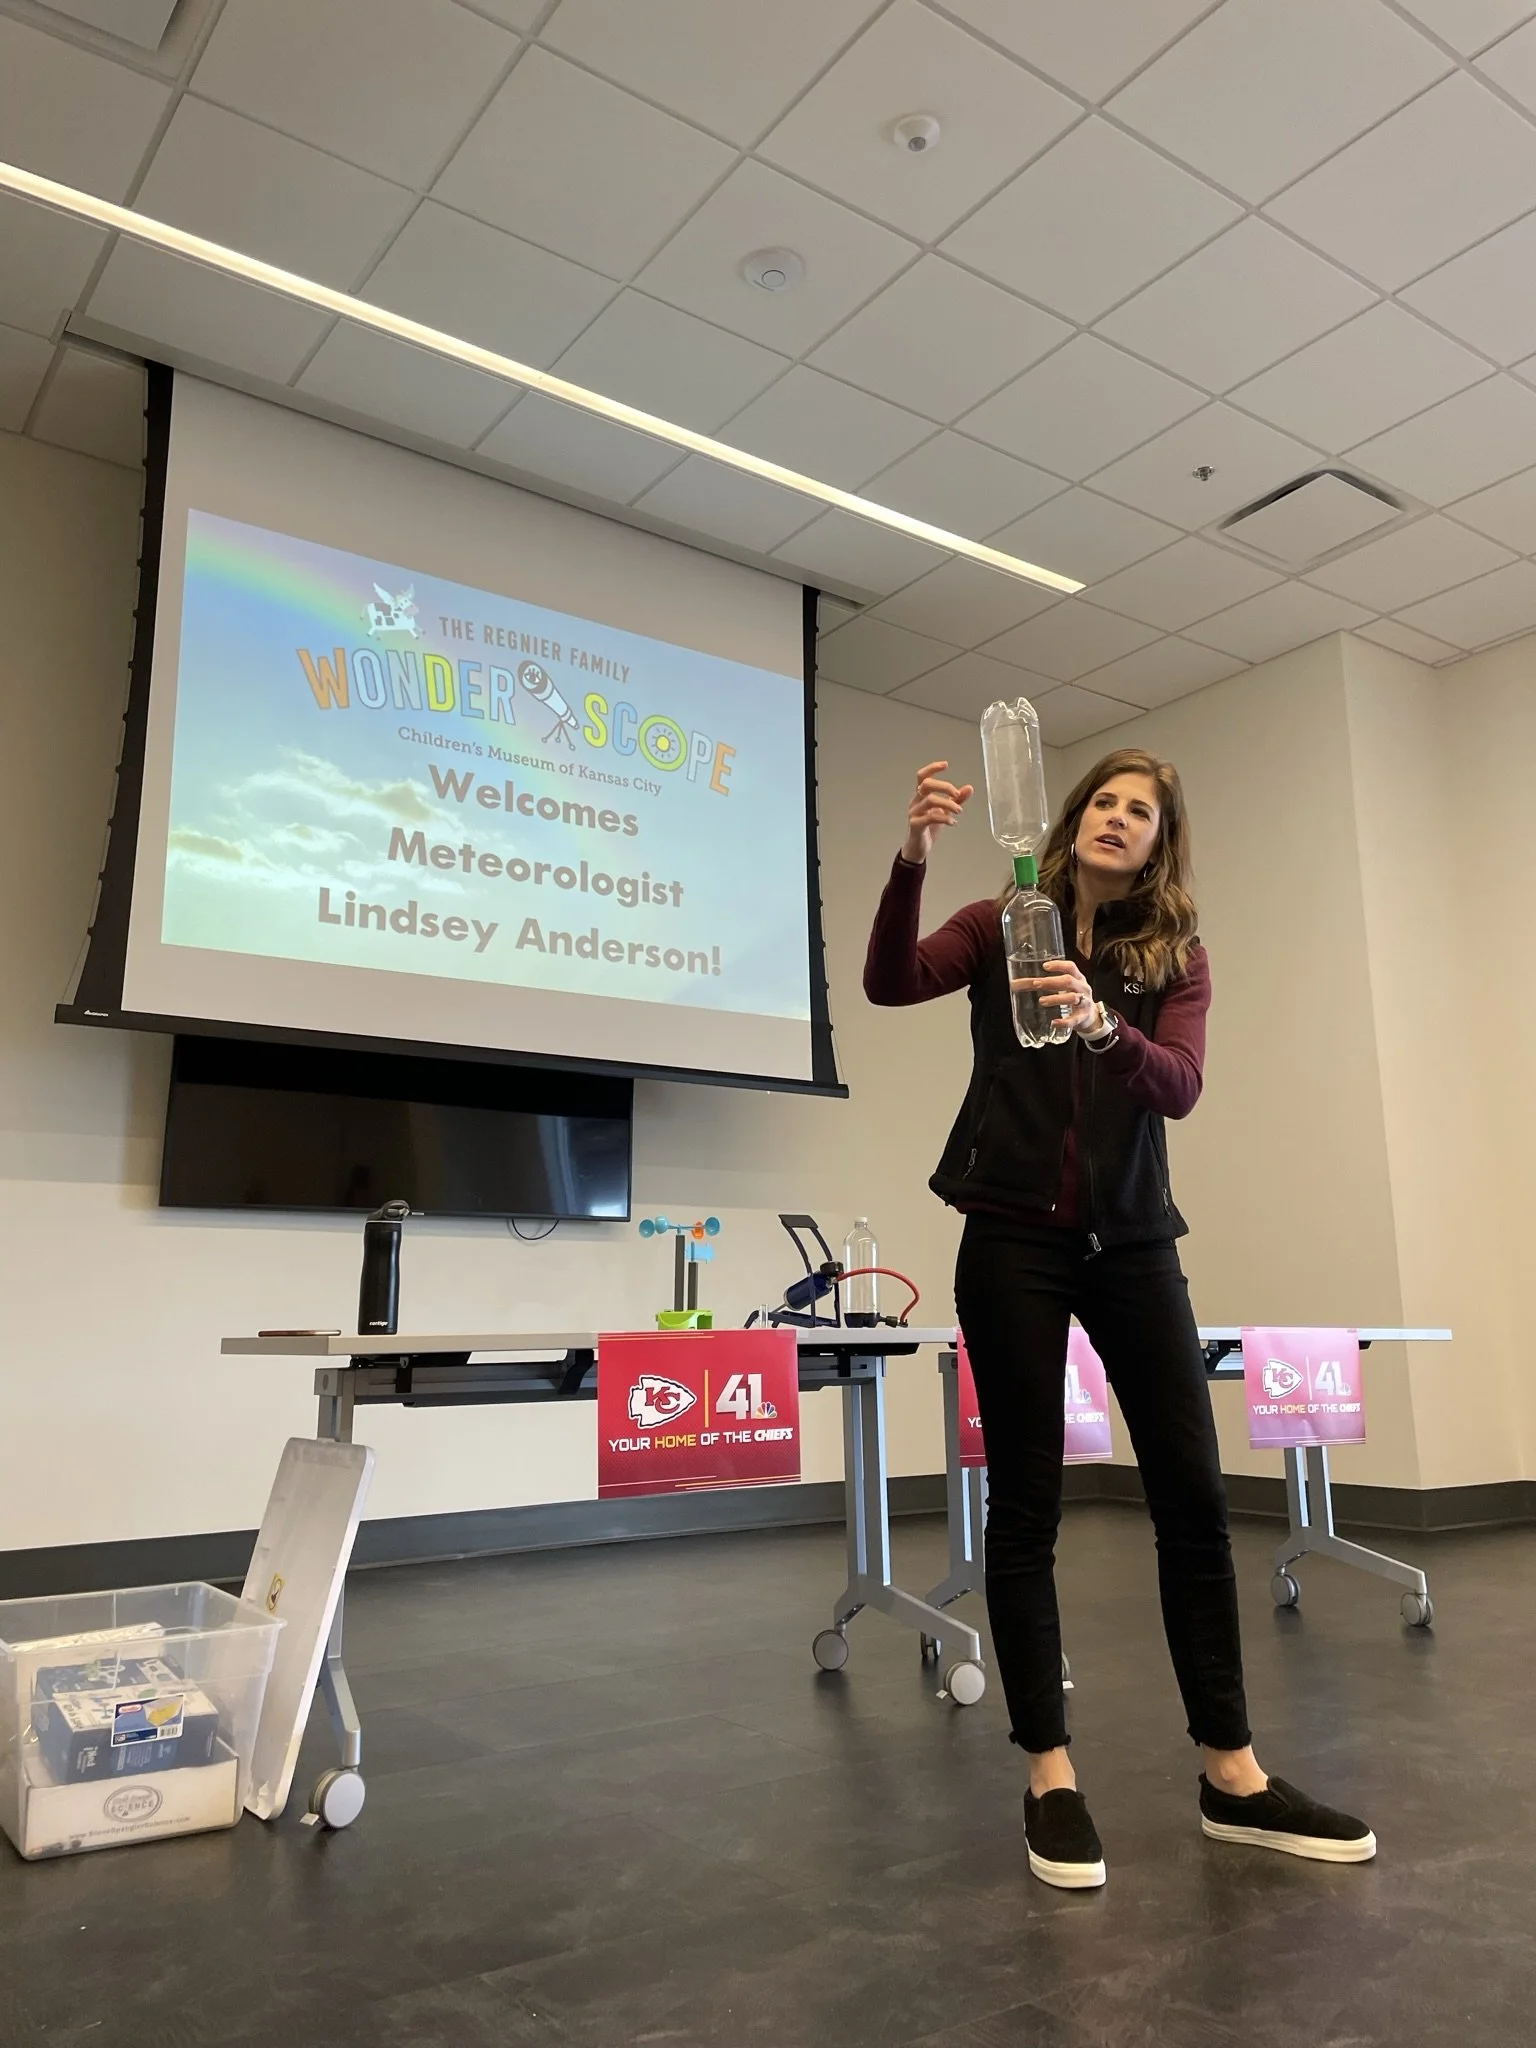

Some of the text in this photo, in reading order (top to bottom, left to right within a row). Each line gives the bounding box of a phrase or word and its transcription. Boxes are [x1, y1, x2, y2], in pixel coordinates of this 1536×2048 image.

[438, 616, 631, 684] THE REGNIER FAMILY
[296, 647, 738, 797] WONDER SCOPE
[398, 726, 662, 797] Children's Museum of Kansas City
[427, 763, 640, 836] Welcomes
[387, 826, 685, 908] Meteorologist
[318, 887, 722, 977] Lindsey Anderson!
[644, 1386, 681, 1414] KC
[715, 1373, 763, 1420] 41
[1272, 1368, 1294, 1388] KC
[1315, 1361, 1343, 1396] 41
[1076, 1412, 1105, 1423] CHIEFS
[1253, 1402, 1361, 1415] YOUR HOME OF THE CHIEFS
[609, 1427, 794, 1453] YOUR HOME OF THE CHIEFS
